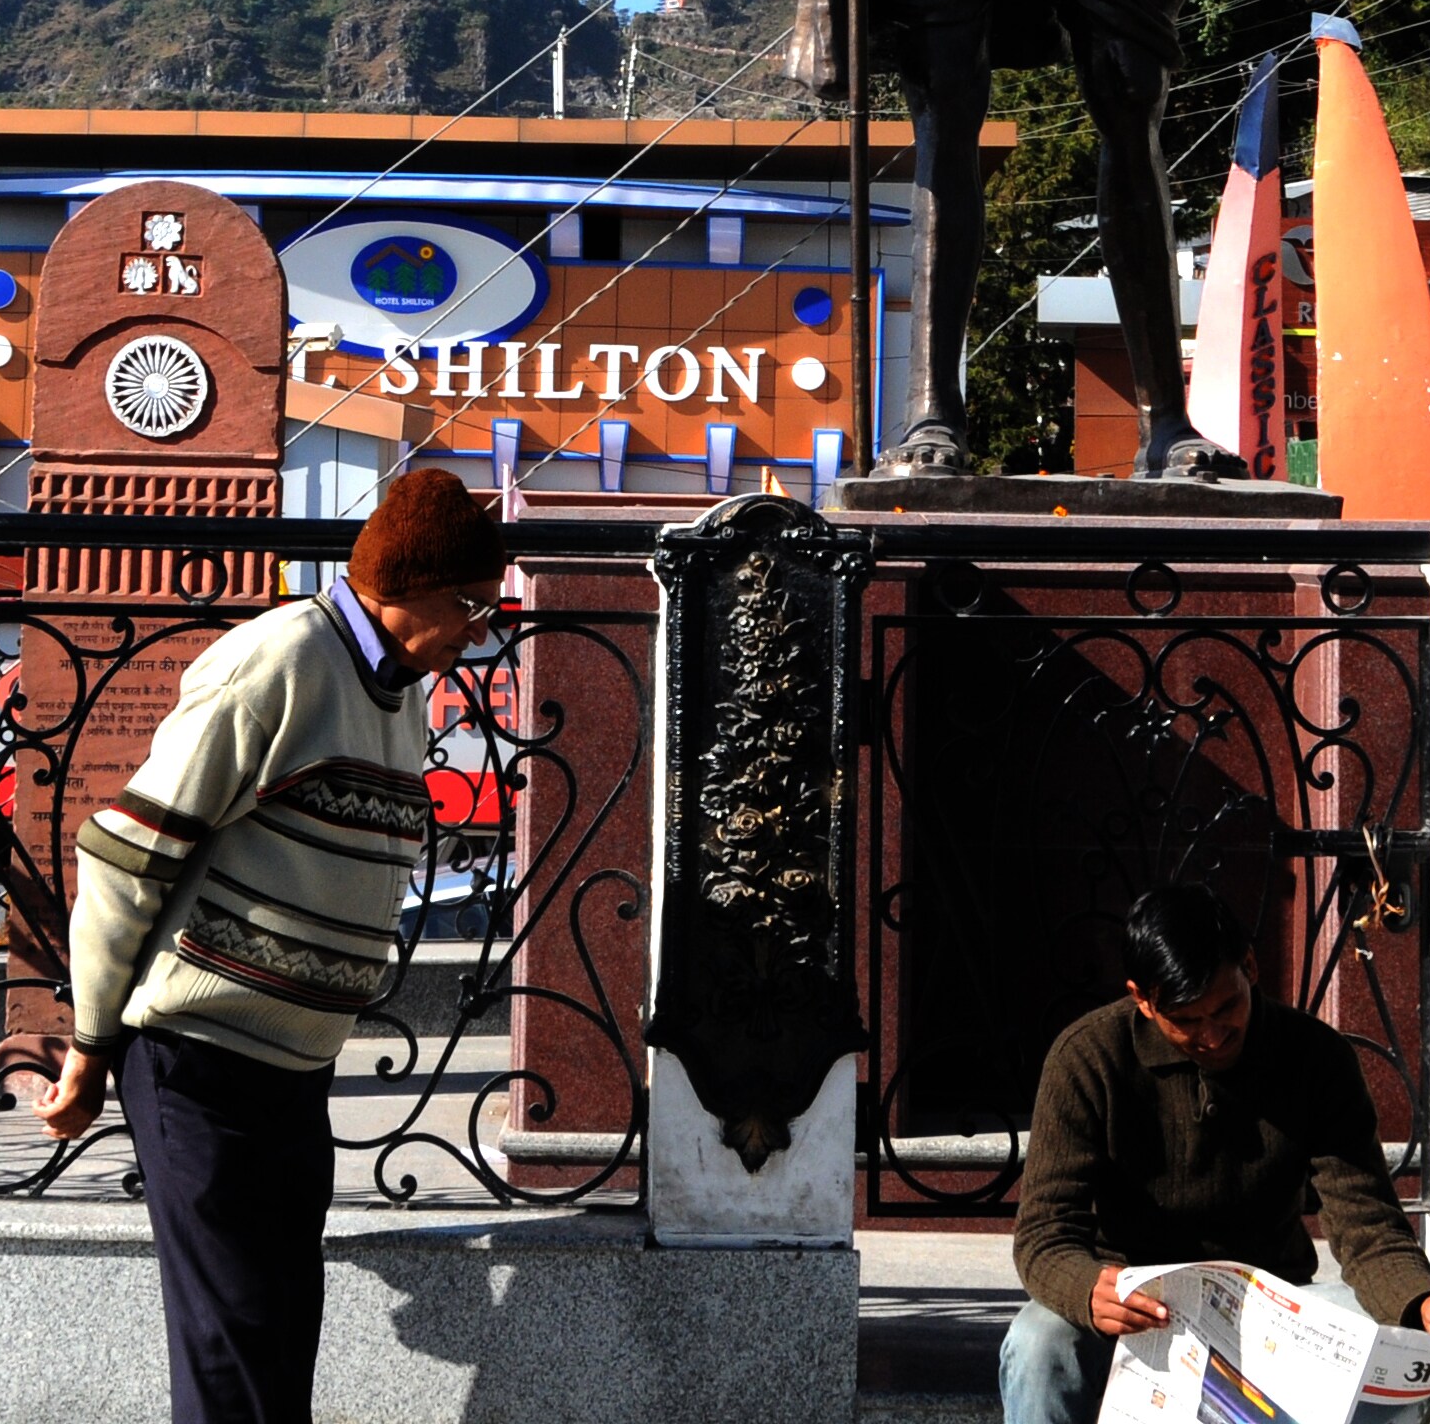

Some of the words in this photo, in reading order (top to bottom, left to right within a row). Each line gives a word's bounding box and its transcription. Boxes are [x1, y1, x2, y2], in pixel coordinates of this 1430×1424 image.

[374, 296, 399, 306] HOTEL
[378, 337, 767, 405] SHILTON
[1251, 251, 1277, 481] CLASSIC
[159, 655, 177, 673] की
